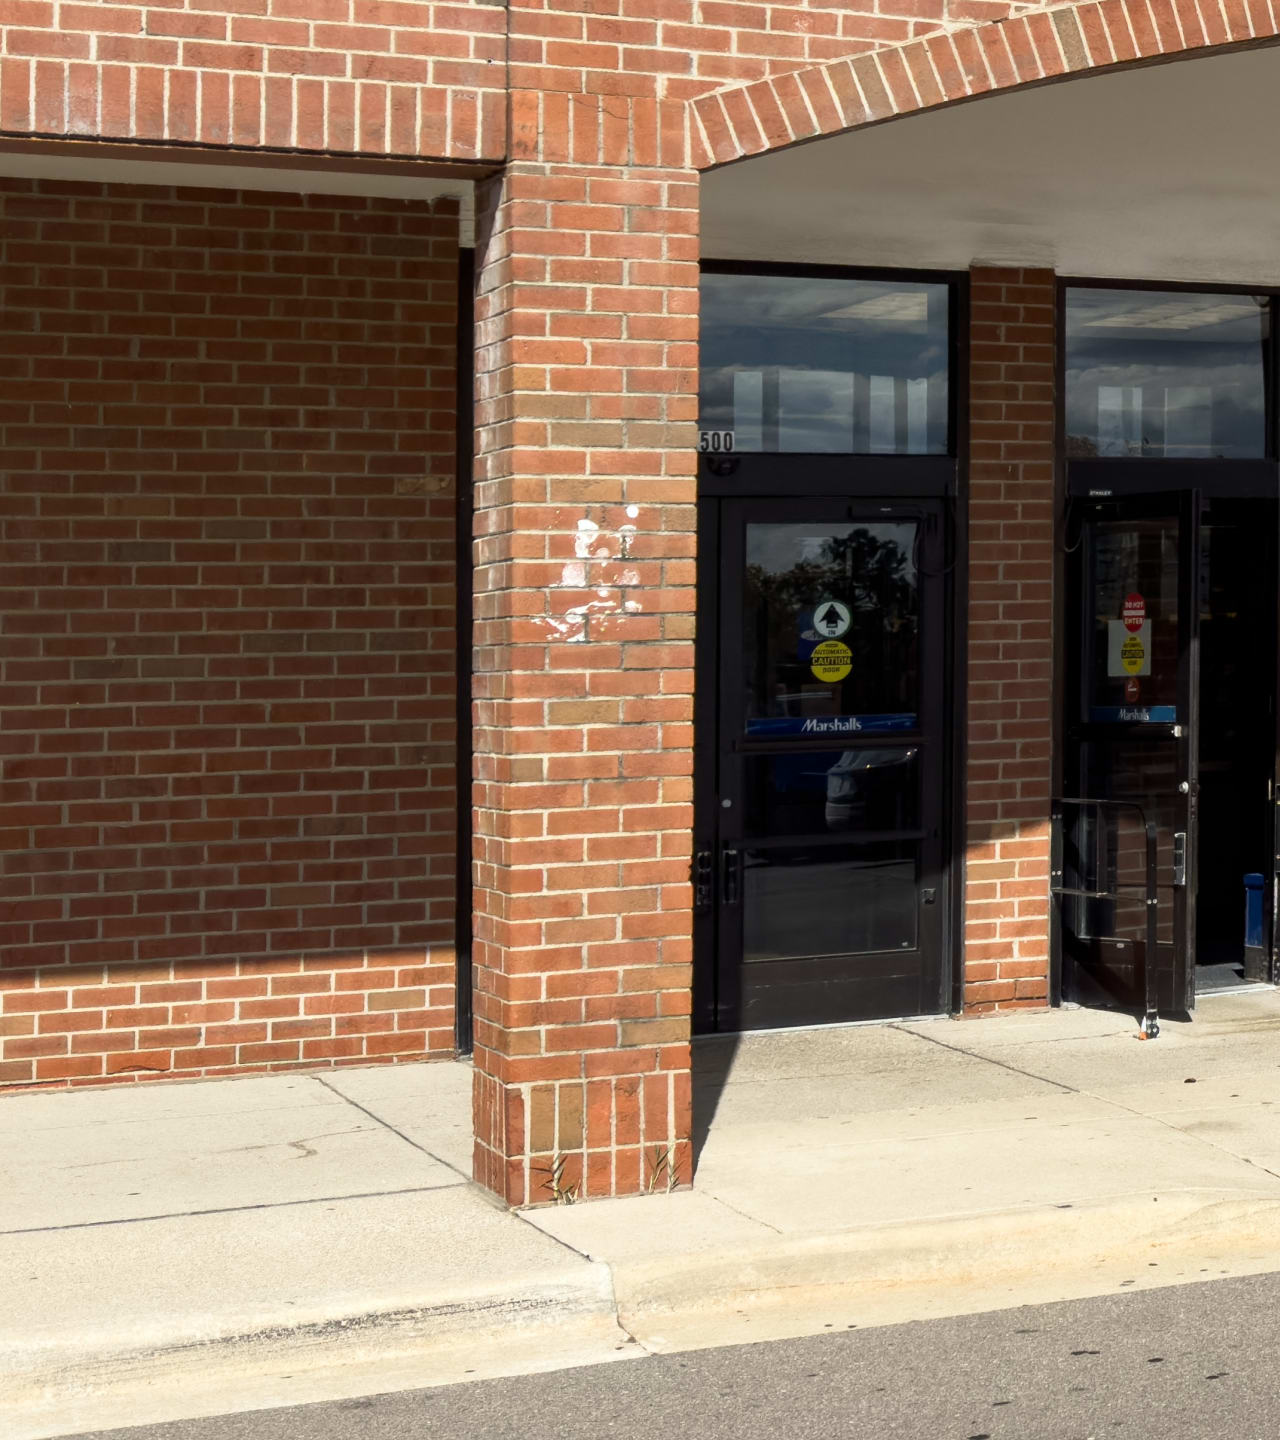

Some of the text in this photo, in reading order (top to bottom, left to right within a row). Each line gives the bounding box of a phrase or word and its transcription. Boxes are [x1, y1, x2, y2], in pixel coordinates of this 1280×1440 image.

[701, 432, 732, 451] 500
[812, 656, 850, 665] CAUTION
[1118, 707, 1149, 721] Marshalls
[801, 717, 862, 732] Marshalls
